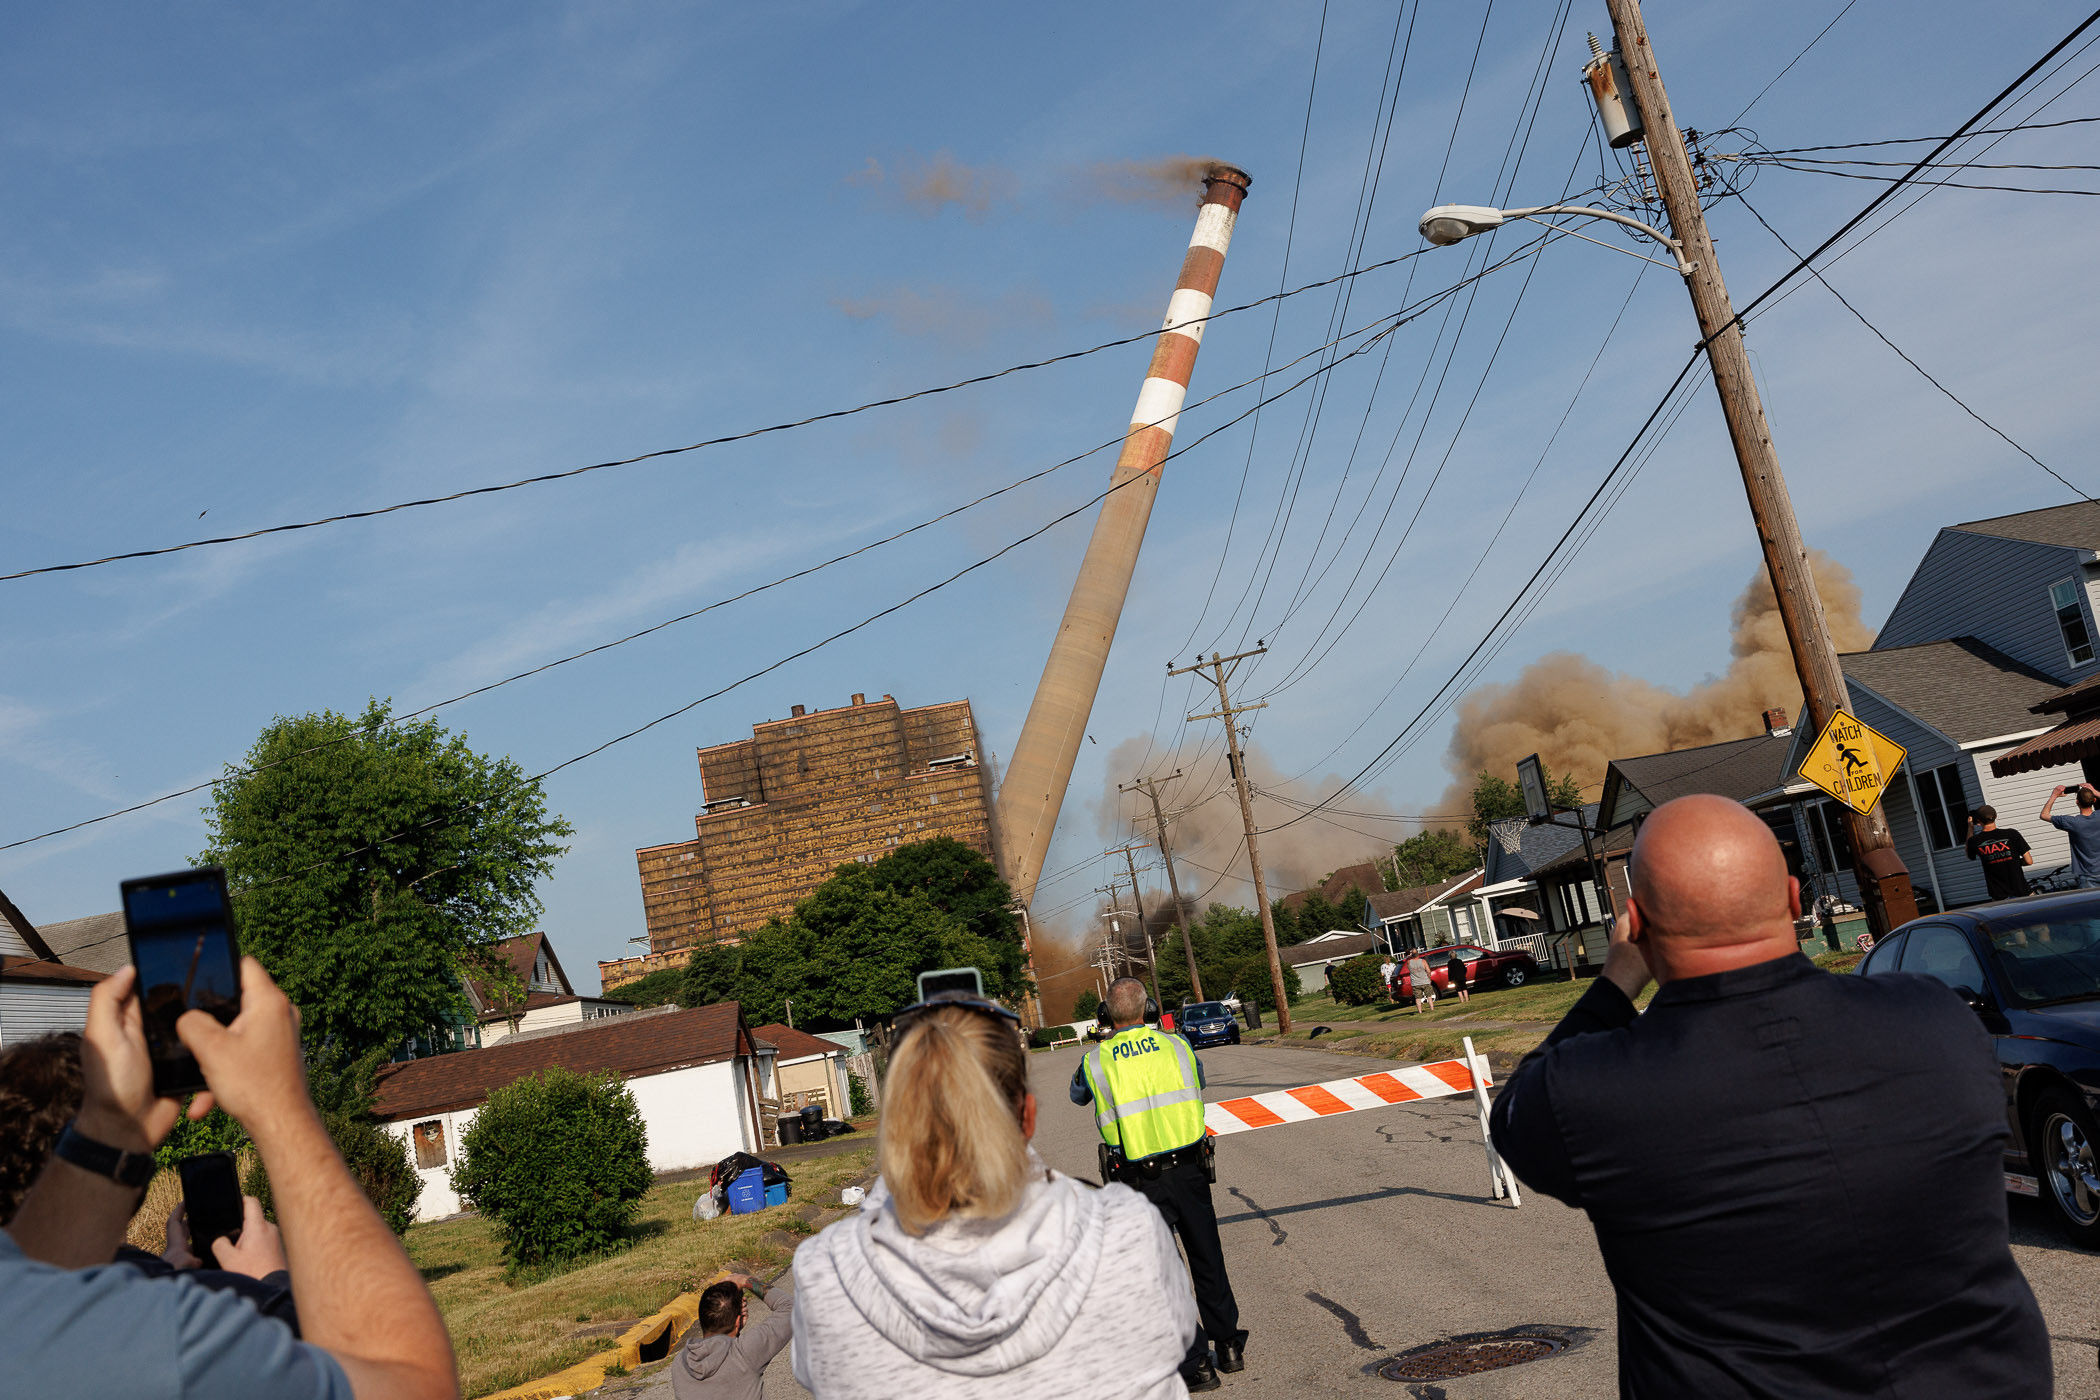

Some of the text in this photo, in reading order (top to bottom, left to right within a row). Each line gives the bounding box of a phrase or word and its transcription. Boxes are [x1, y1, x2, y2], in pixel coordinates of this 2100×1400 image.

[1828, 725, 1862, 743] WATCH
[1833, 773, 1882, 794] CHILDREN
[1978, 842, 2010, 855] MAX
[1112, 1037, 1160, 1061] POLICE
